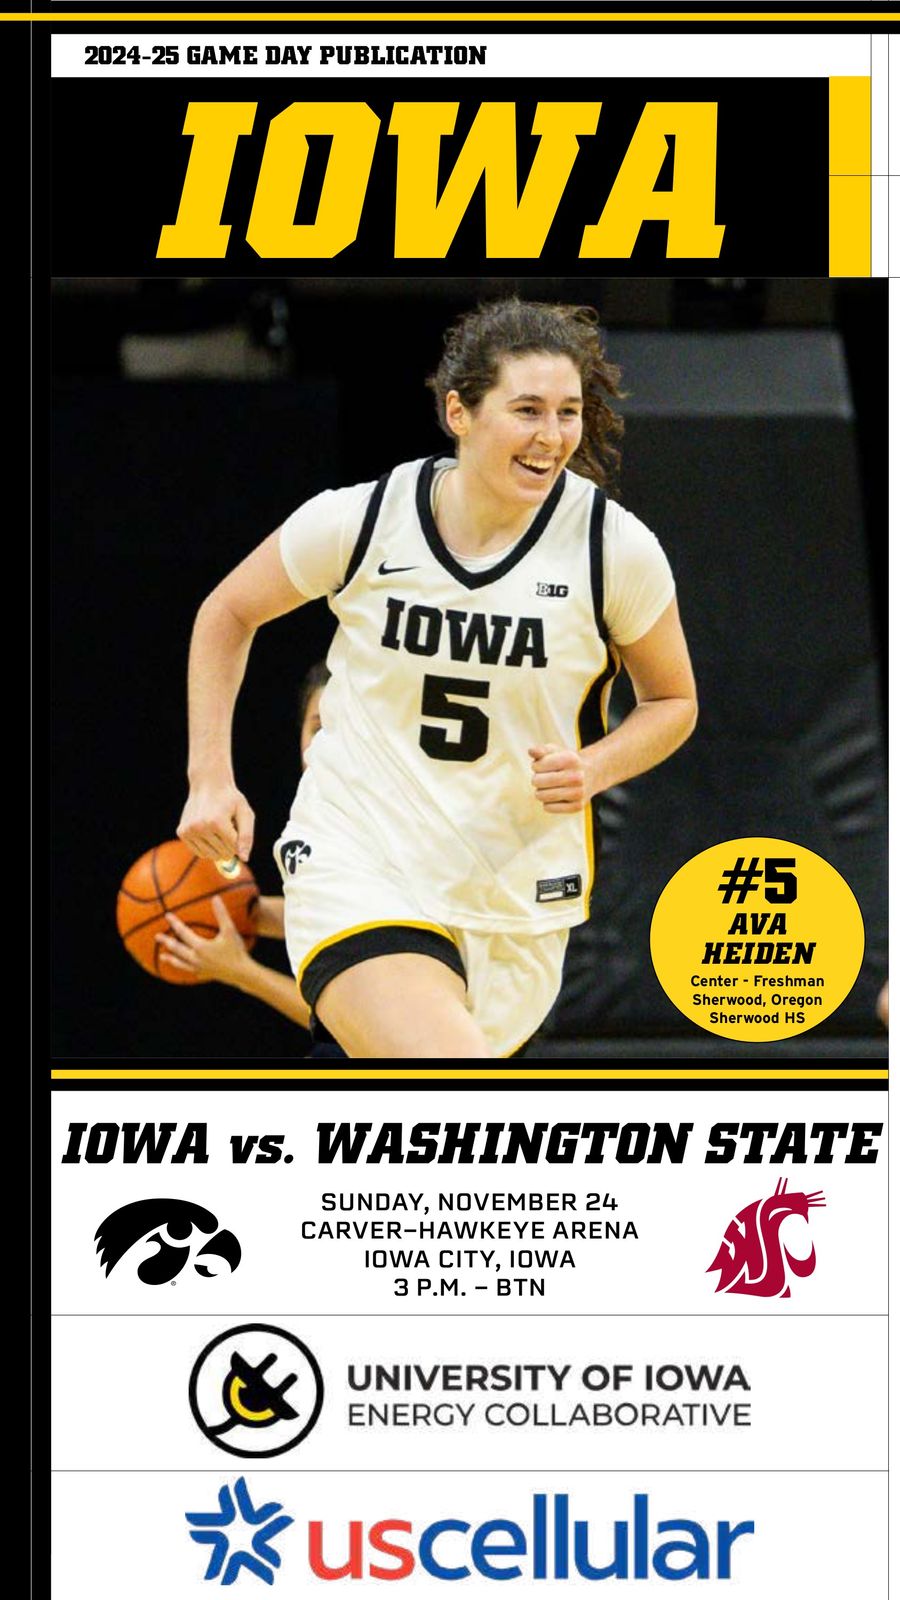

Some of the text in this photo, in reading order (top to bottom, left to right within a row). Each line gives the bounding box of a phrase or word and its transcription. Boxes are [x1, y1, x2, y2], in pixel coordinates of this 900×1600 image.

[84, 45, 488, 66] 2024-25 GAME DAY PUBLICATION
[155, 101, 727, 259] IOWA
[380, 597, 549, 669] IOWA
[418, 673, 491, 763] 5
[565, 881, 579, 894] XL
[717, 856, 798, 905] #5
[727, 912, 788, 936] AVA
[701, 941, 817, 965] HEIDEN
[690, 974, 739, 987] Center
[753, 974, 825, 988] Freshman
[692, 993, 823, 1009] Sherwood, Oregon
[708, 1011, 806, 1025] Sherwood HS
[60, 1122, 882, 1165] IOWA vs. WASHINGTON STATE
[321, 1192, 619, 1216] SUNDAY, NOVEMBER 24
[552, 1221, 639, 1240] ARENA
[365, 1249, 576, 1273] IOWA CITY, IOWA
[393, 1277, 409, 1297] 3
[417, 1278, 467, 1297] P.M.
[496, 1278, 545, 1297] BTN
[347, 1364, 752, 1392] UNIVERSITY OF IOWA
[348, 1402, 752, 1427] ENERGY COLLABORATIVE
[308, 1493, 755, 1581] uscellular
